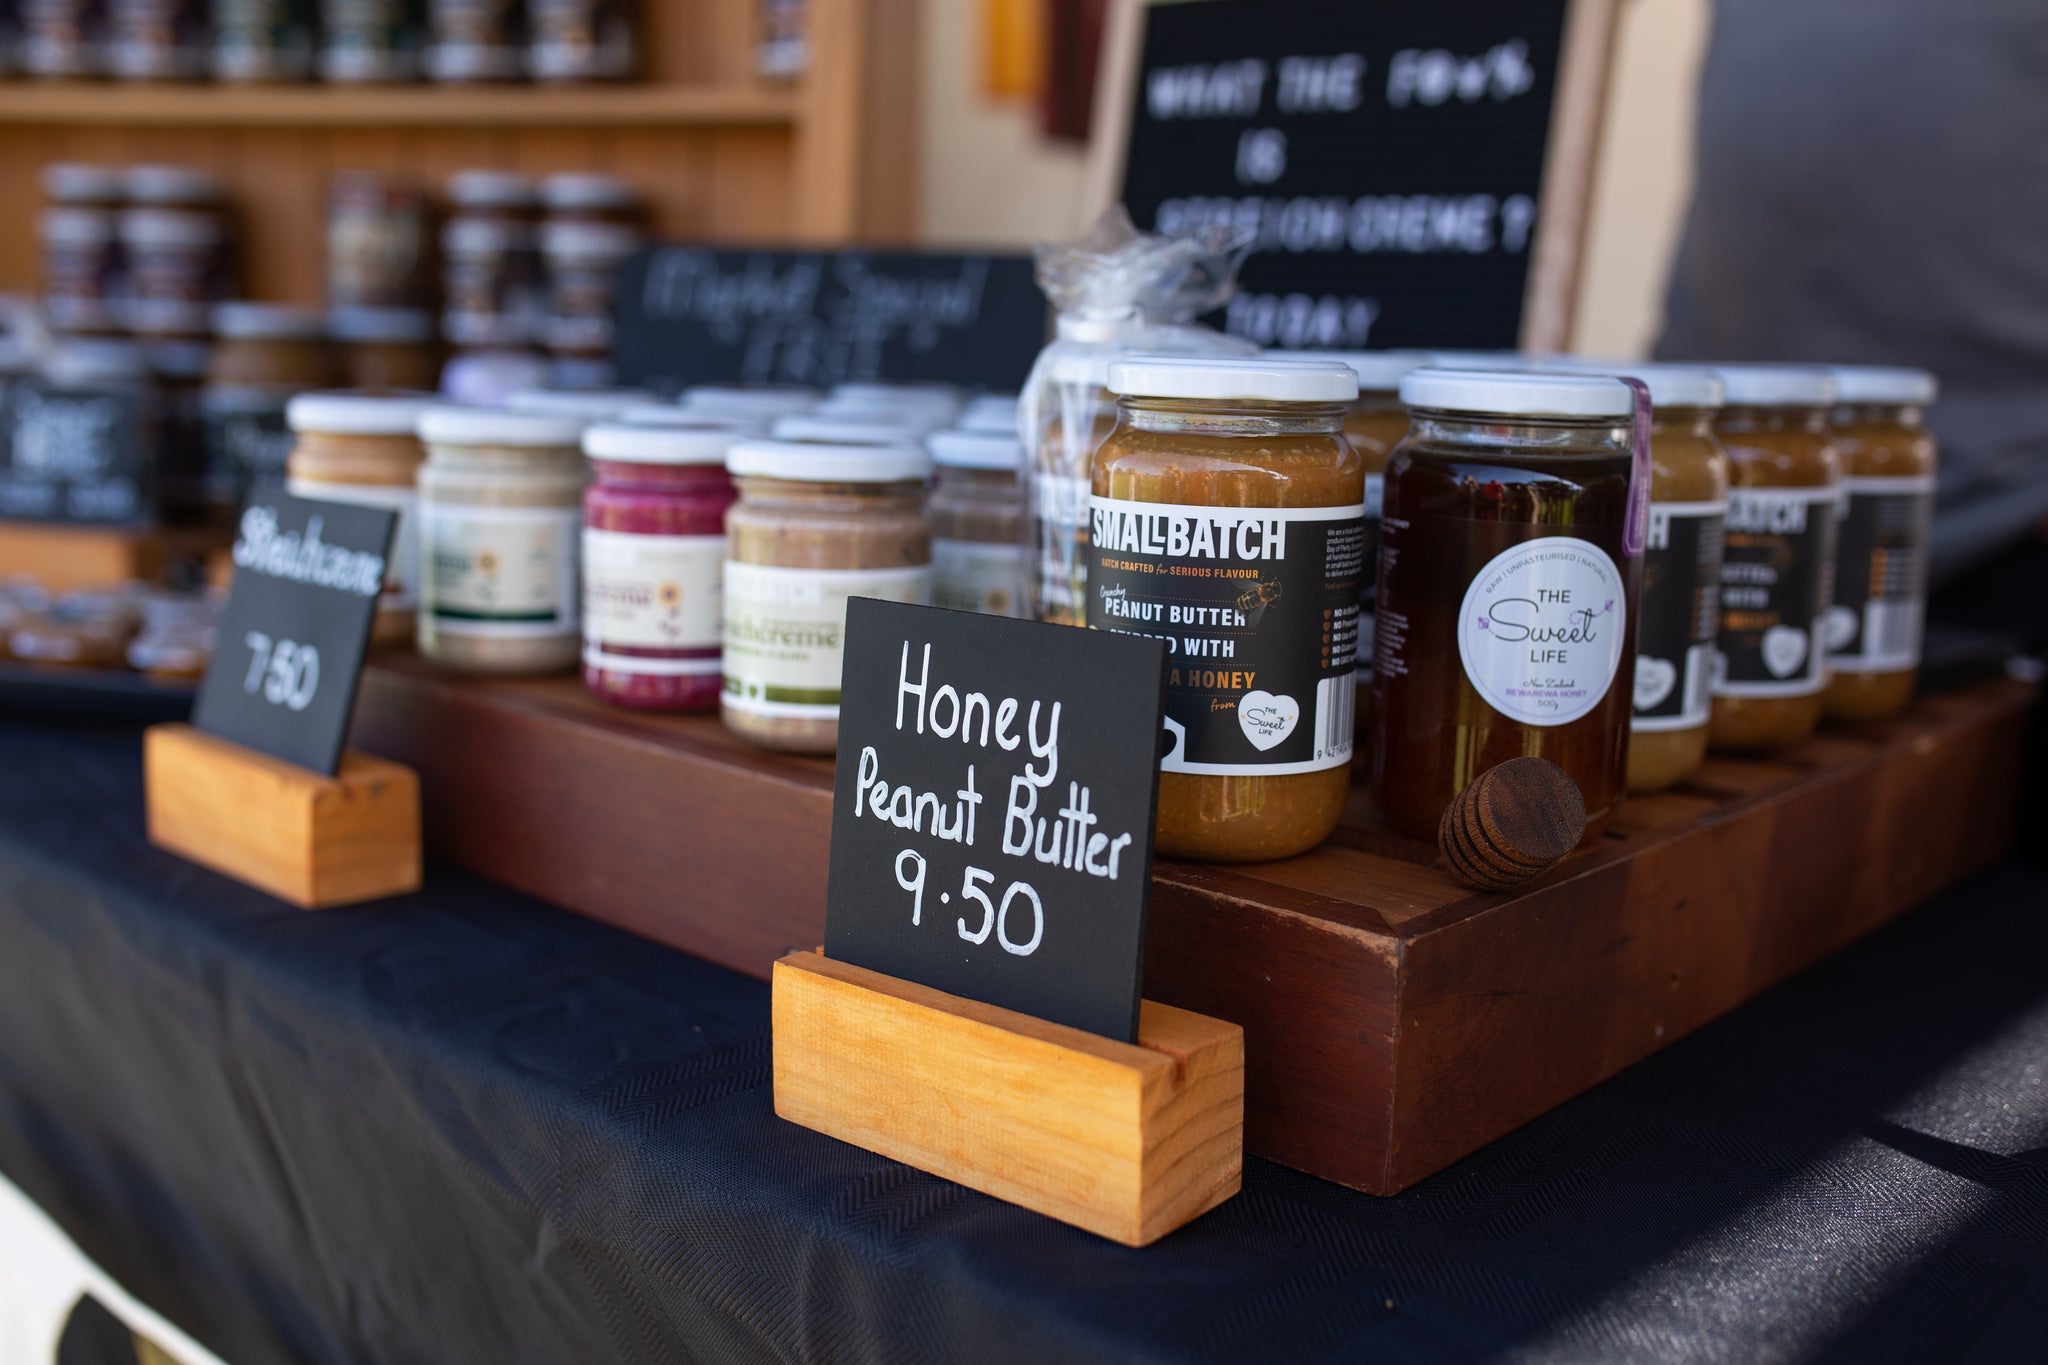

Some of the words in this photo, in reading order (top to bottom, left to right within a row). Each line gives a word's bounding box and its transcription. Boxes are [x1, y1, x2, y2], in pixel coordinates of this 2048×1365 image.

[1147, 58, 1268, 119] WHAT
[1277, 53, 1366, 113] THE
[1235, 127, 1287, 183] IS
[1101, 557, 1119, 569] BATCH
[1120, 560, 1154, 573] CRAFTED
[1156, 563, 1168, 575] for
[1169, 566, 1212, 578] SERIOUS
[1214, 568, 1259, 579] FLAVOUR
[1485, 577, 1502, 594] RAW
[1507, 552, 1577, 574] UNPASTEURISED
[1537, 589, 1572, 604] THE
[1104, 597, 1164, 623] PEANUT
[1169, 605, 1246, 627] BUTTER
[1489, 598, 1597, 643] Sweet
[1184, 638, 1235, 658] WITH
[1530, 650, 1568, 664] LIFE
[1189, 669, 1256, 689] HONEY
[1560, 689, 1588, 698] HONEY
[895, 640, 1061, 788] Honey
[1210, 698, 1236, 713] from
[1265, 706, 1277, 715] THE
[1246, 708, 1287, 730] Sweet
[855, 745, 983, 846] Peanut
[1002, 774, 1132, 881] Butter
[895, 849, 1044, 957] 9.50
